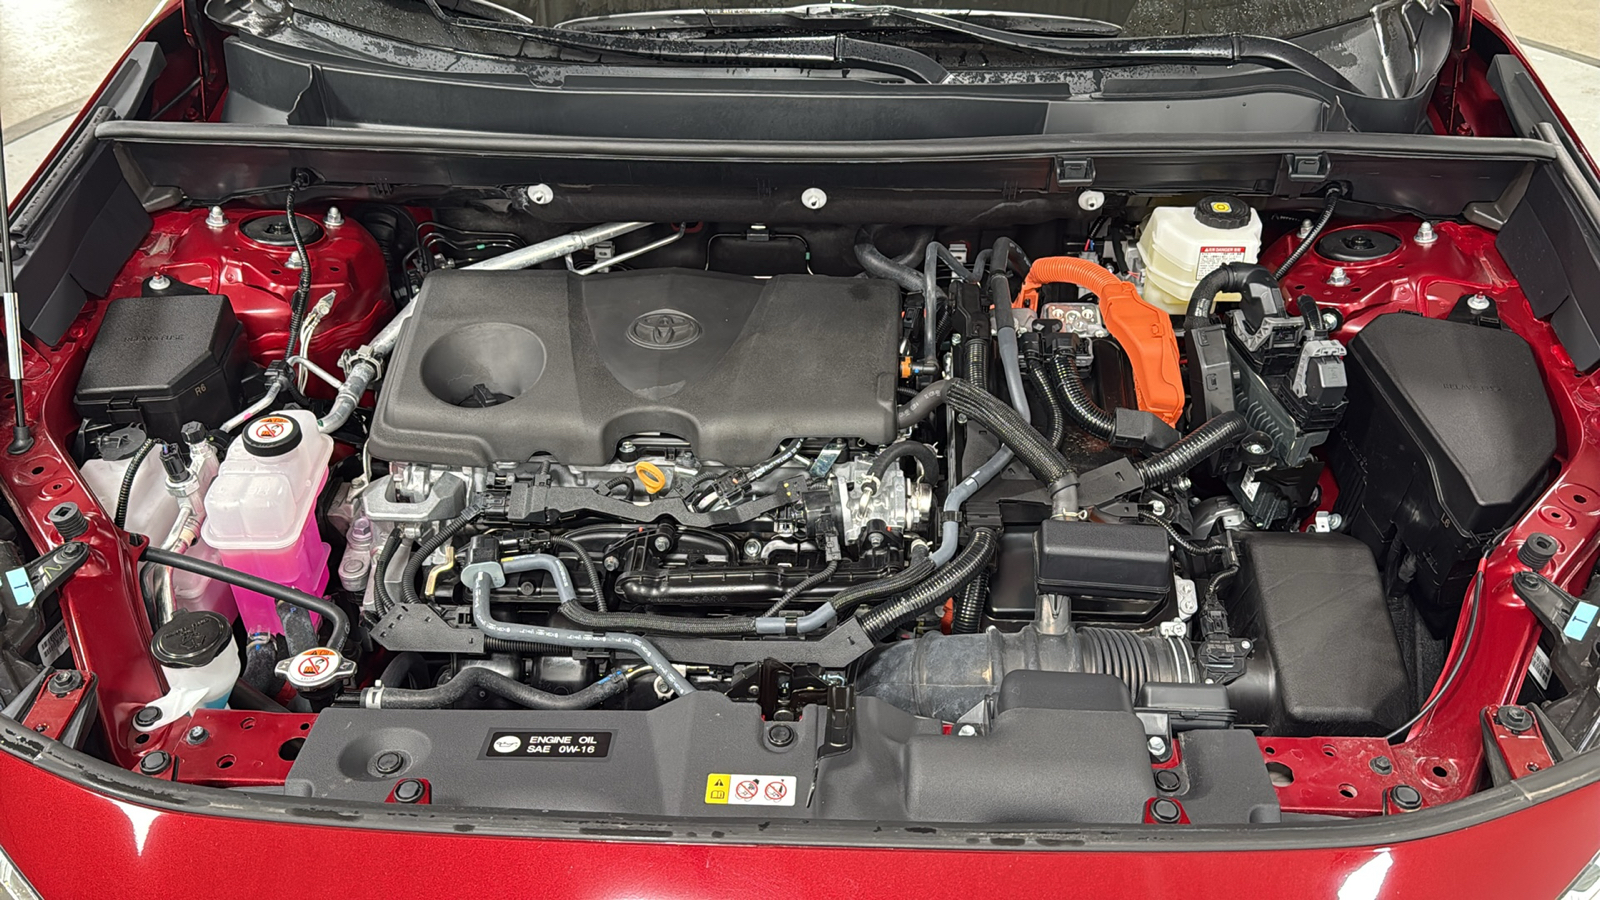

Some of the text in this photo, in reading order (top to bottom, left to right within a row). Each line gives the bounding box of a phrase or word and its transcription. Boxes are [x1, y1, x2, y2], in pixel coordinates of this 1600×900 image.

[194, 383, 207, 396] R6
[529, 736, 597, 744] ENGINE OIL
[526, 745, 595, 754] SAE 0W-16
